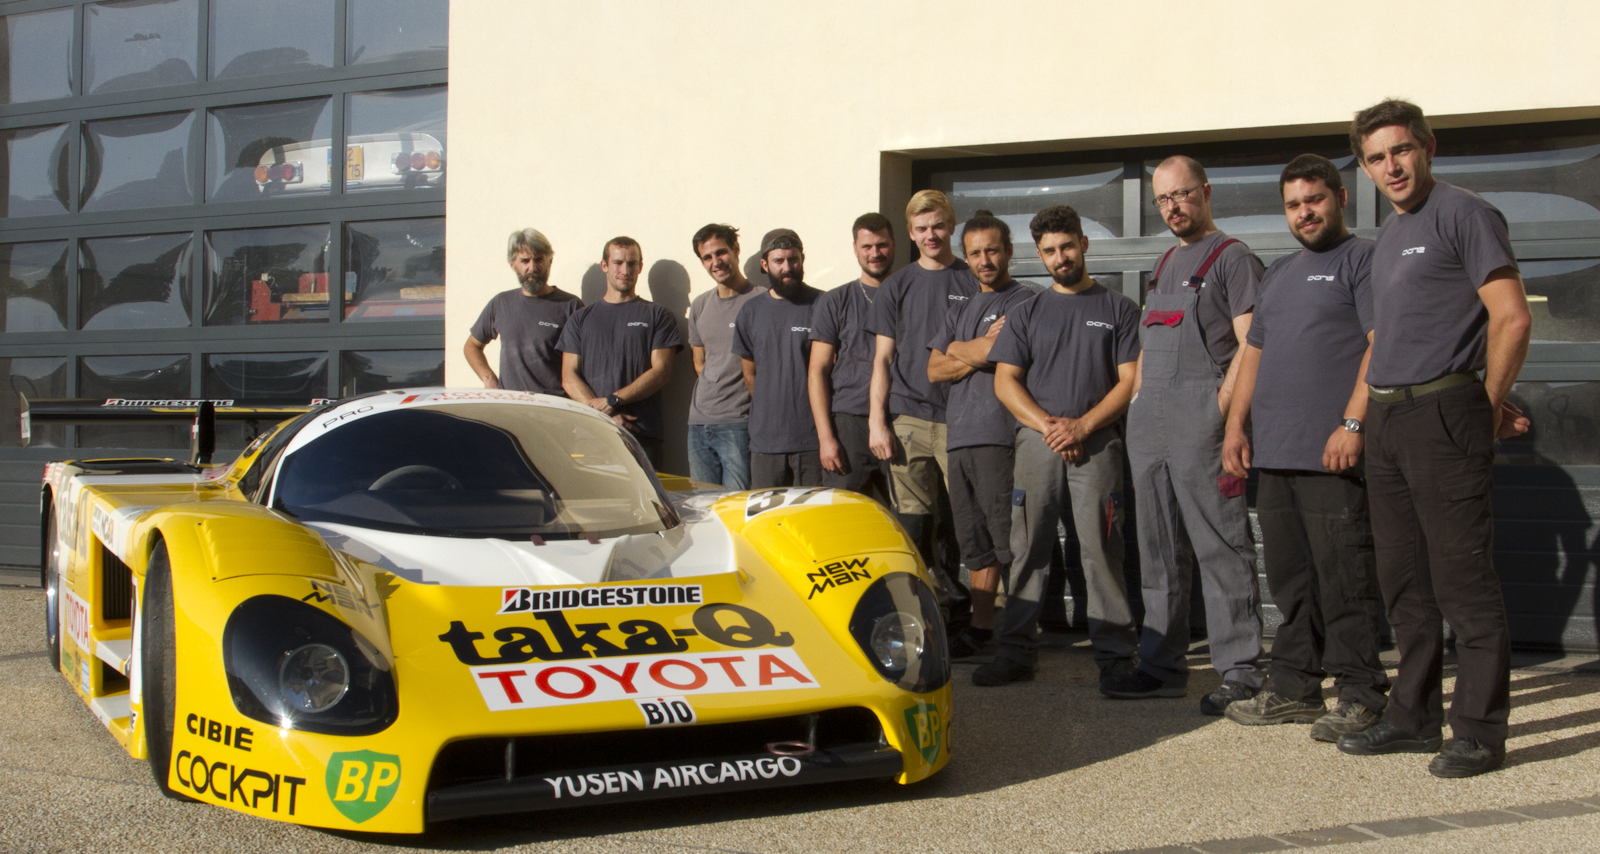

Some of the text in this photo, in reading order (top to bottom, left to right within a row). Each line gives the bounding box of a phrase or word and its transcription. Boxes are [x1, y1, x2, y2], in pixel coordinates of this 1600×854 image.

[323, 405, 374, 428] PRO
[502, 586, 700, 612] BRIDGESTONE
[438, 602, 795, 666] taka-Q
[477, 654, 813, 704] TOYOTA
[912, 710, 940, 749] BP
[176, 750, 306, 816] COCKPIT
[333, 760, 399, 802] BP
[544, 755, 801, 798] YUSEN AIRCARGO
